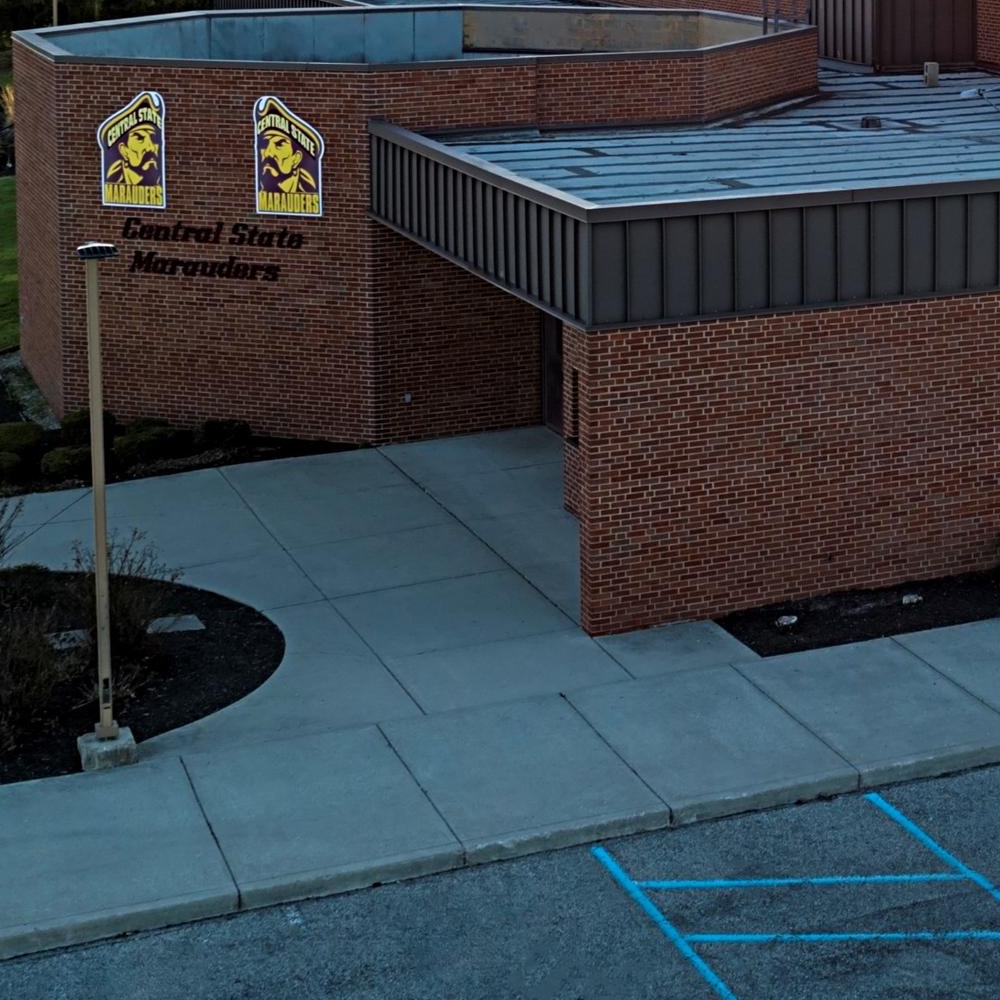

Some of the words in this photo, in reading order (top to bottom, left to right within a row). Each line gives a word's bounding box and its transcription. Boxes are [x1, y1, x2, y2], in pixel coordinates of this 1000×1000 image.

[107, 112, 138, 147] CENTRAL
[138, 107, 163, 129] STATE
[257, 114, 290, 135] CENTRAL
[290, 124, 316, 157] STATE
[105, 183, 163, 205] MARAUDERS
[259, 191, 319, 213] MARAUDERS
[121, 217, 225, 245] Central
[228, 222, 304, 249] State
[129, 250, 282, 281] Marauders
